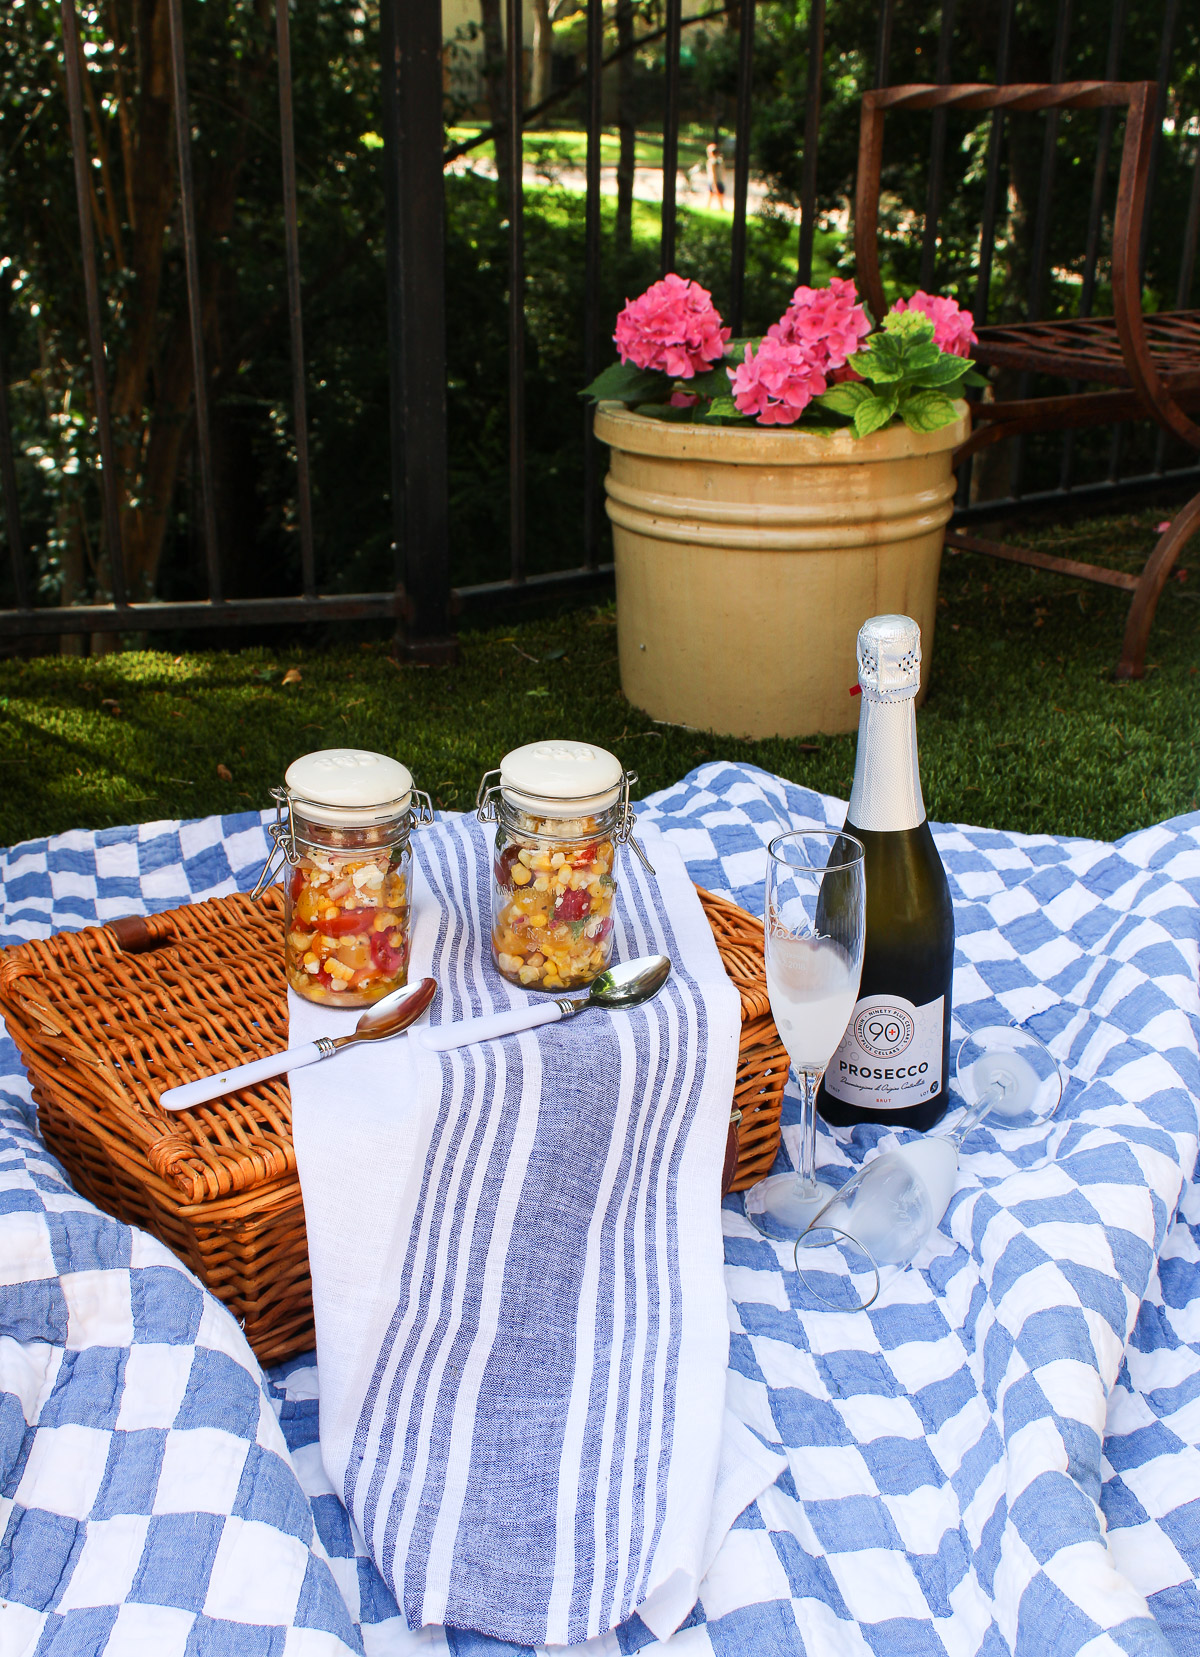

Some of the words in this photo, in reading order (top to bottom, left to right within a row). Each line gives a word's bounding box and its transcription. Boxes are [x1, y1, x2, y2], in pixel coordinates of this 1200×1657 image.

[893, 1011, 906, 1020] PLUS
[873, 1047, 900, 1056] CELLARS
[839, 1060, 928, 1080] PROSECCO
